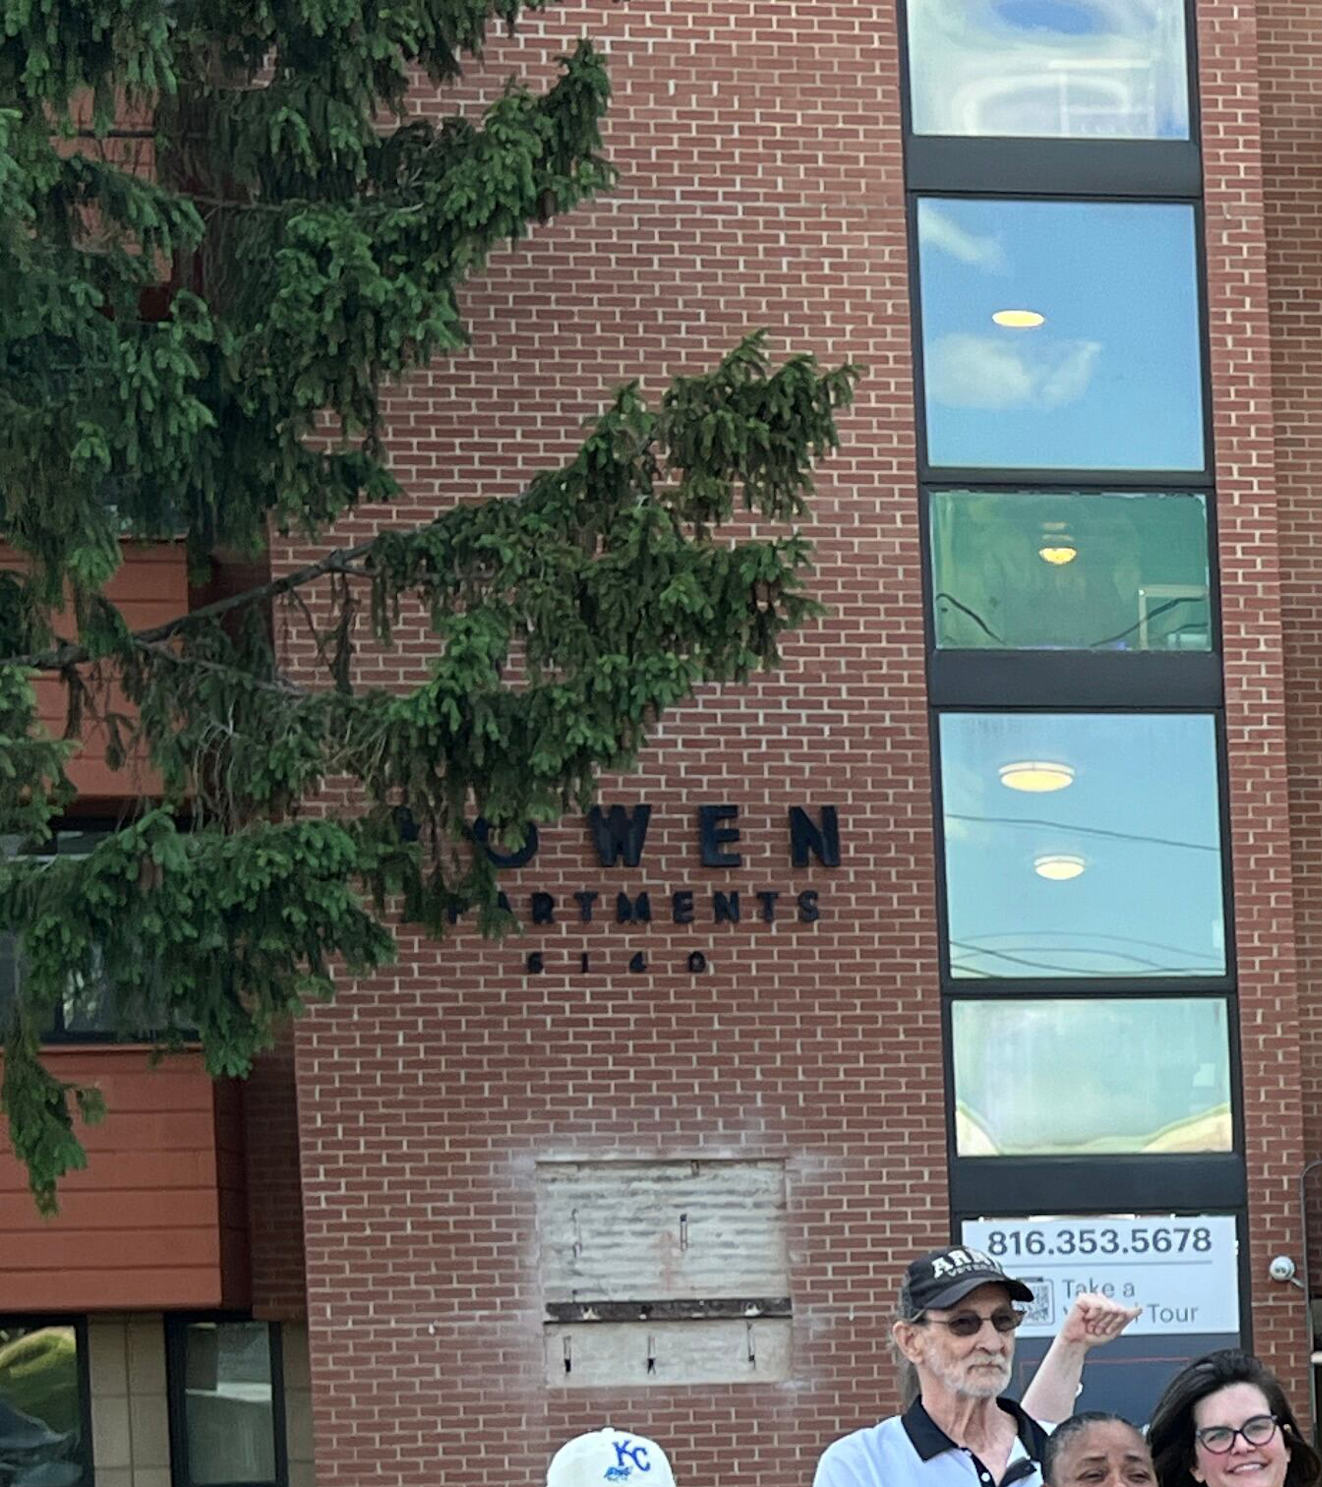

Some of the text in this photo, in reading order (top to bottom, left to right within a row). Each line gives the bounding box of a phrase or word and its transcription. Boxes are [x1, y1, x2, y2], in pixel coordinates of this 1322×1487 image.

[391, 804, 840, 868] OWEN
[988, 1228, 1212, 1255] 816.353.5678
[1062, 1278, 1136, 1297] Take a
[1149, 1304, 1199, 1323] Tour
[612, 1440, 651, 1472] KC
